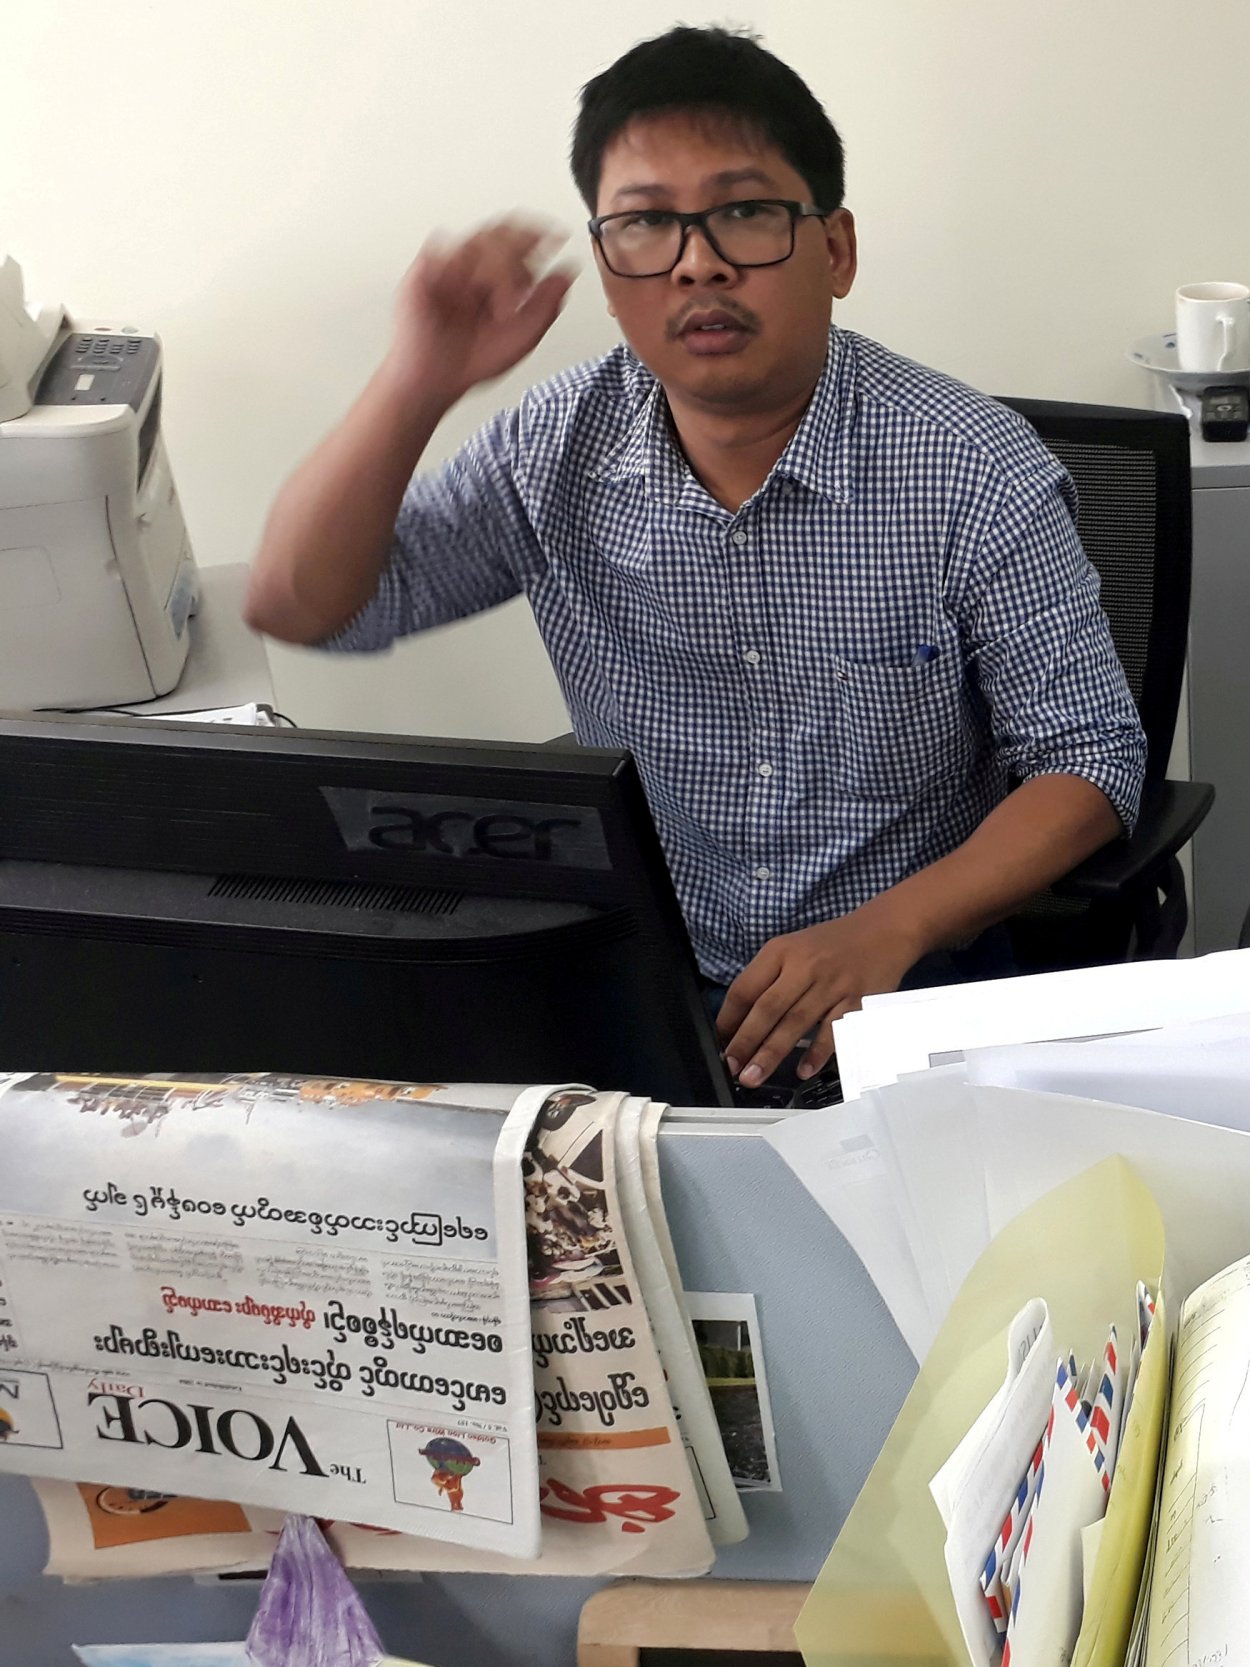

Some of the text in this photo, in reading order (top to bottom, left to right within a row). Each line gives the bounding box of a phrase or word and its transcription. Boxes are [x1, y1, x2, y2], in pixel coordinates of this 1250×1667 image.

[368, 806, 581, 860] acer
[87, 1378, 145, 1398] Daily
[87, 1392, 366, 1485] The VOICE
